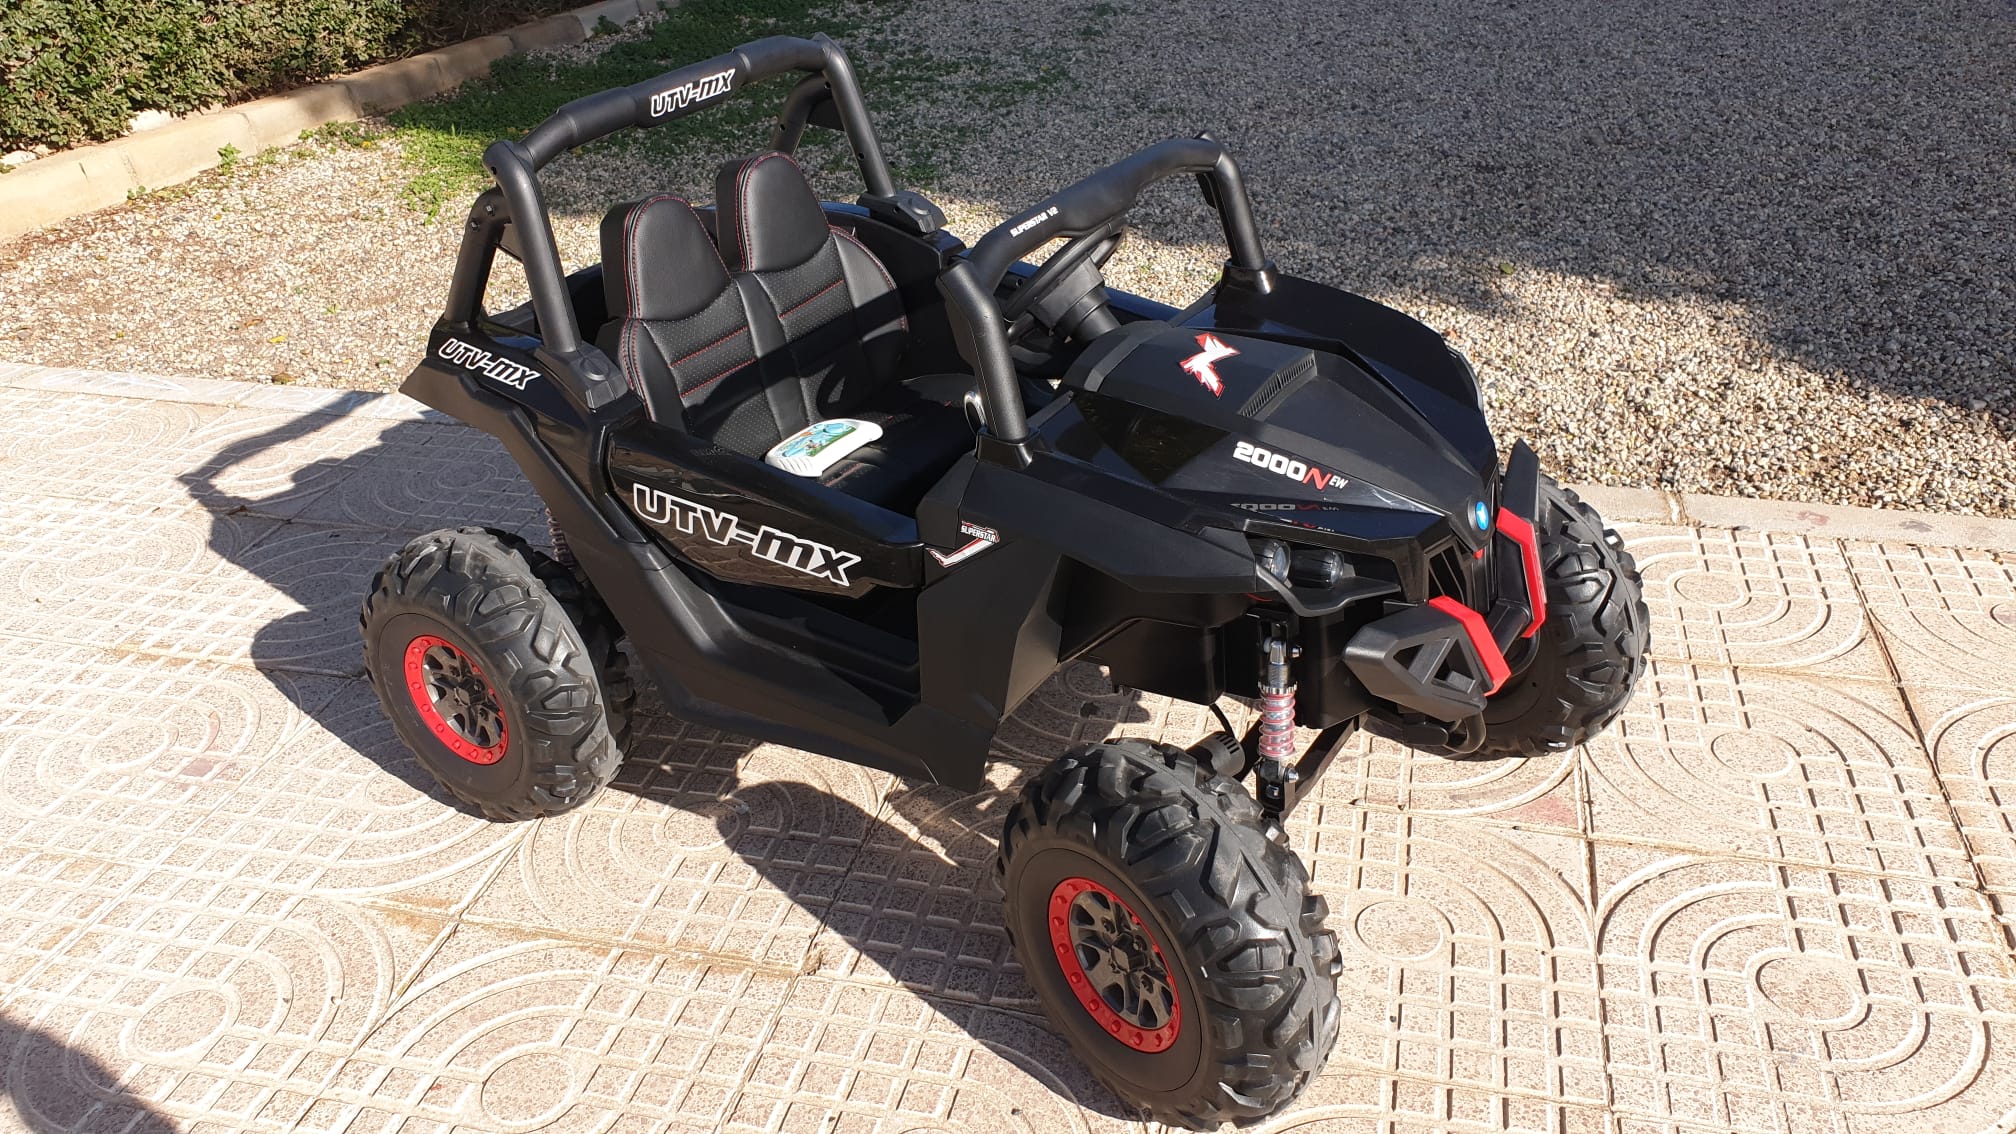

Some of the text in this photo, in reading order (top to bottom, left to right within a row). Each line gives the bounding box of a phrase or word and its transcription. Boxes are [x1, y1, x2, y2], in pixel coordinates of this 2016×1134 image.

[651, 68, 735, 117] UTV-MX
[438, 338, 541, 390] UTV-MX
[633, 483, 861, 587] UTV-MX
[960, 525, 996, 543] SUPERSTAR
